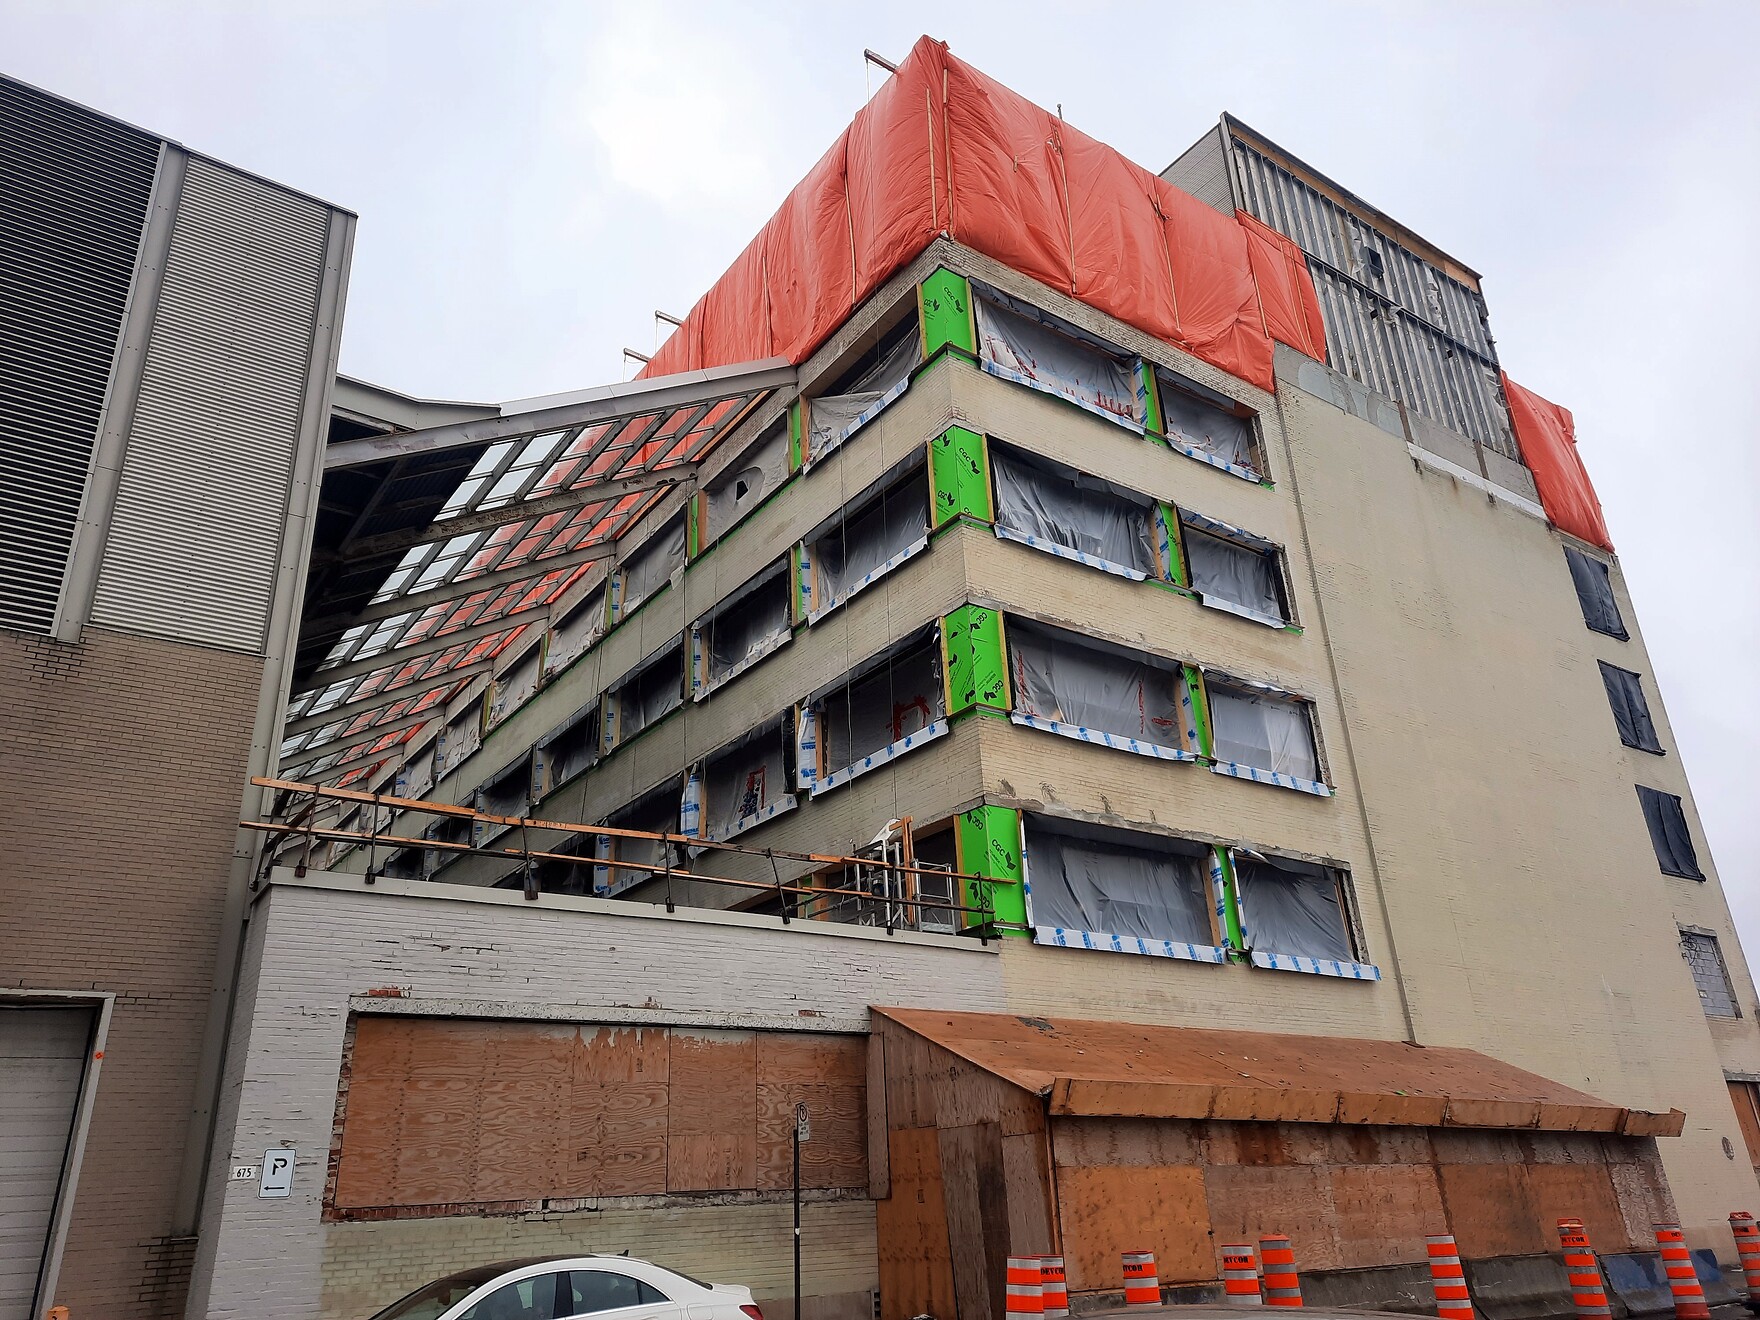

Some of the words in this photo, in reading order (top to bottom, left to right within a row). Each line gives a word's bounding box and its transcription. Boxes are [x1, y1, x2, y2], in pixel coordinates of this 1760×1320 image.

[944, 287, 955, 301] CGC
[959, 447, 971, 462] CGC
[976, 612, 988, 625] CGC
[992, 680, 1004, 693] CGC
[992, 839, 1006, 857] CGC
[236, 1167, 252, 1178] 675
